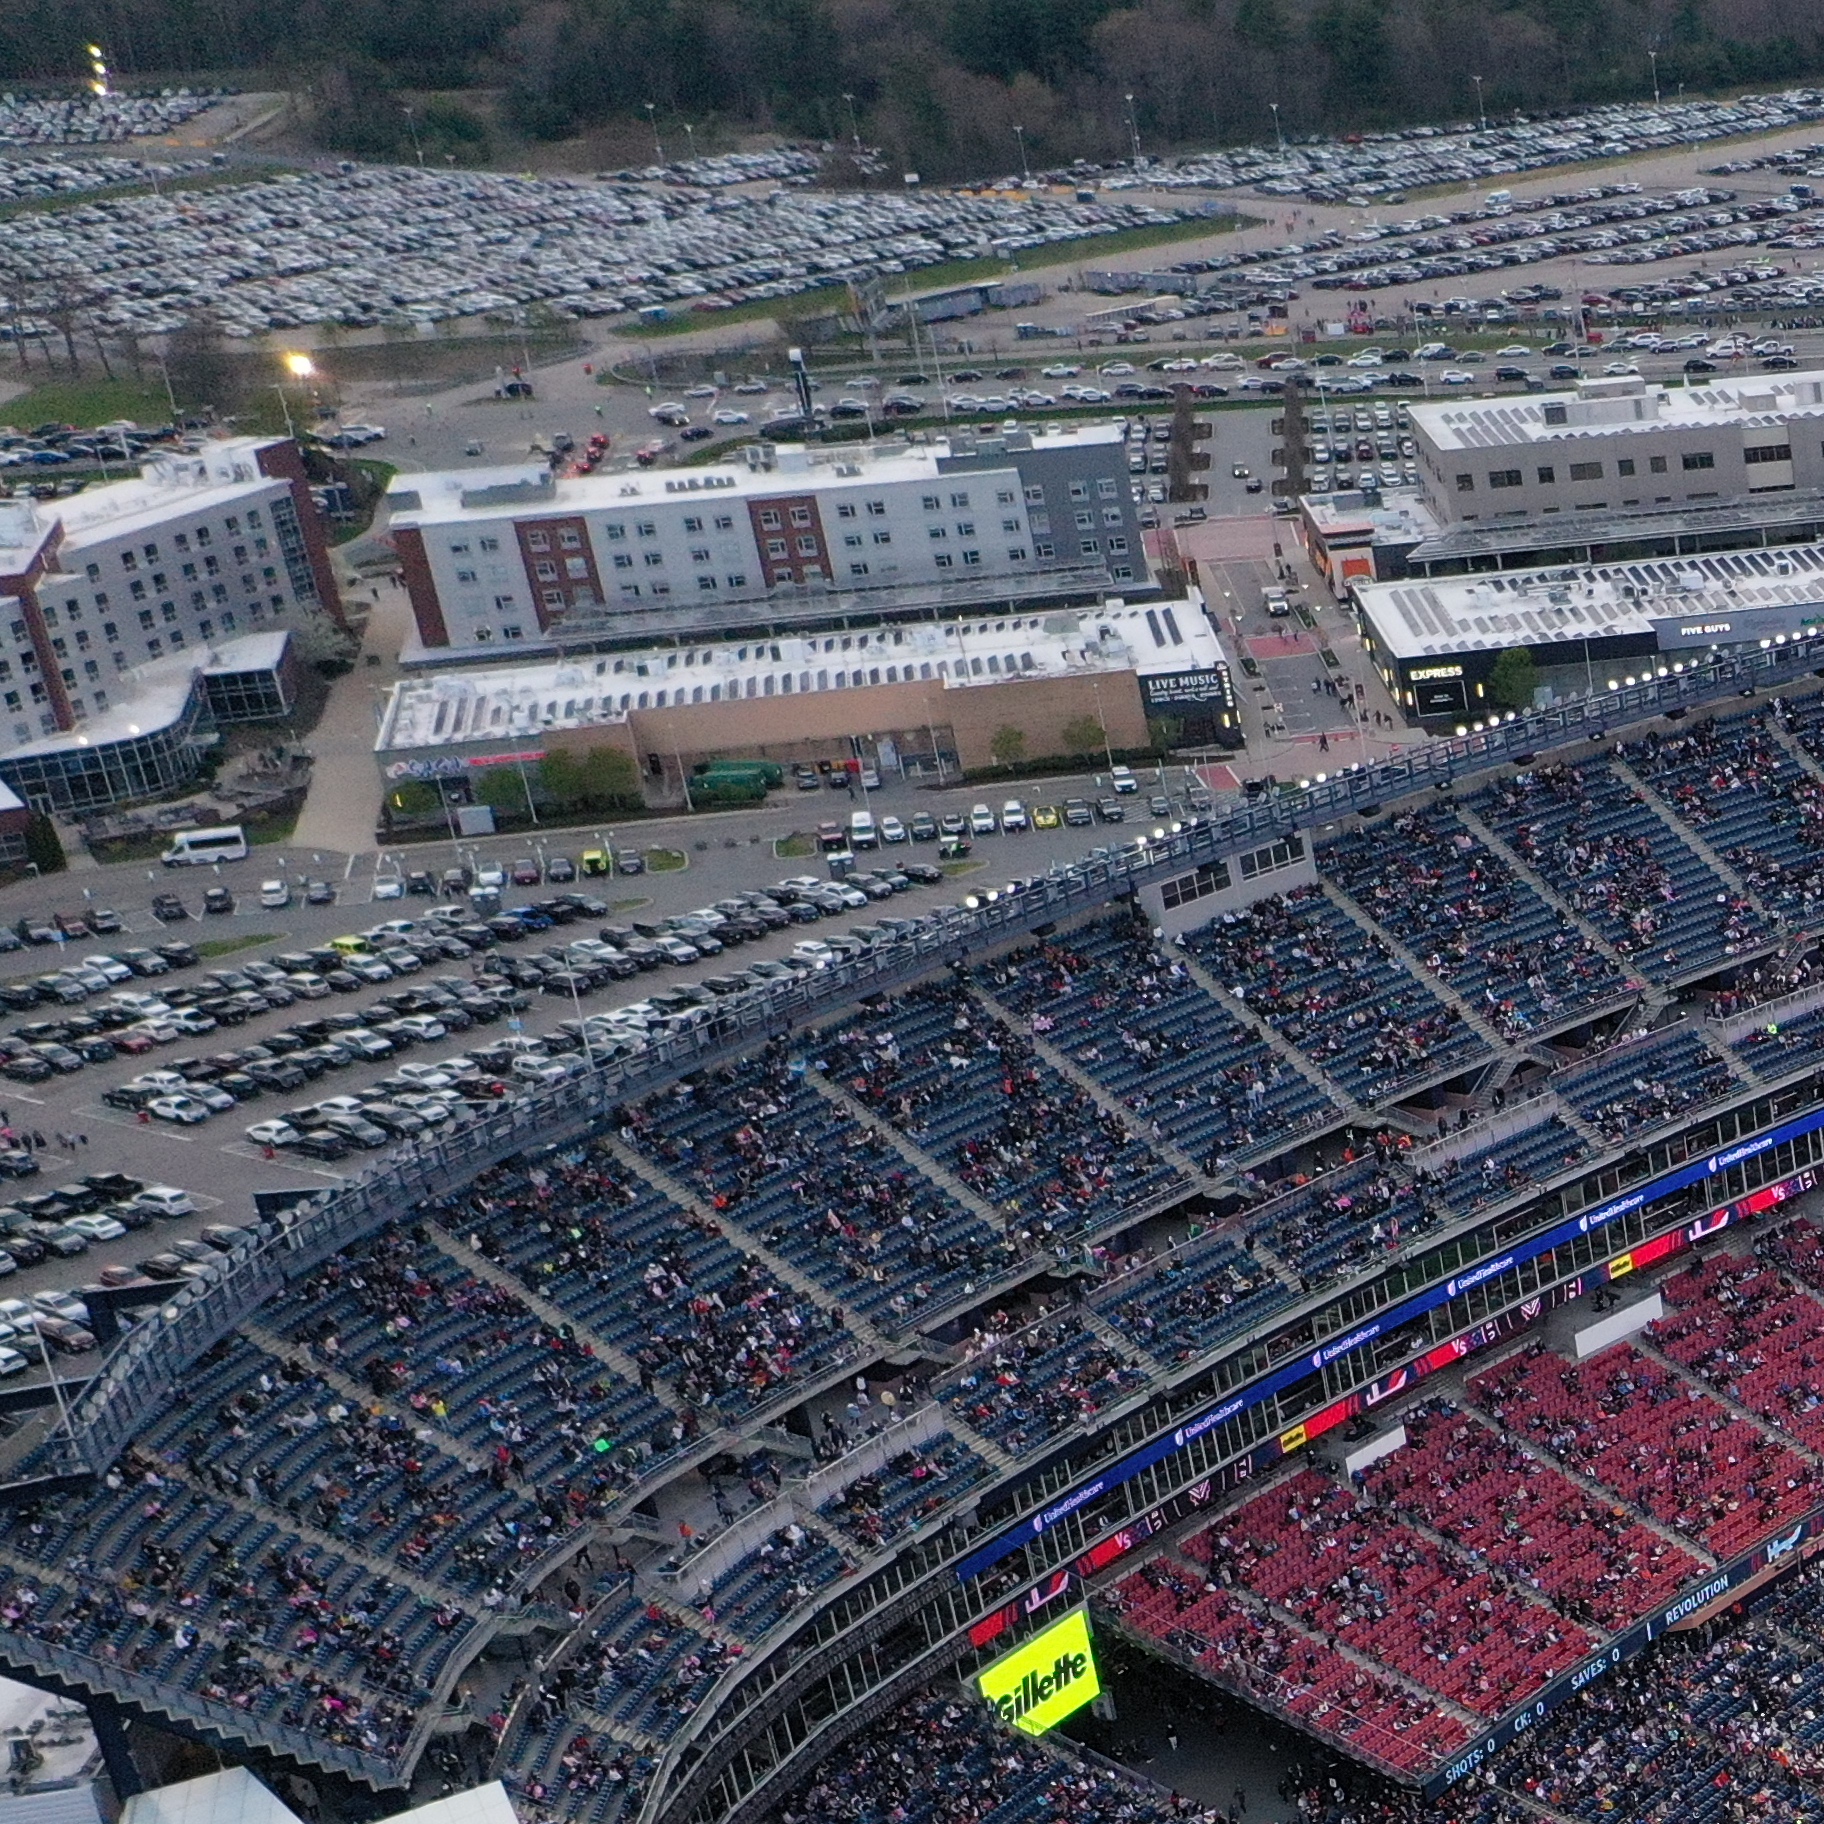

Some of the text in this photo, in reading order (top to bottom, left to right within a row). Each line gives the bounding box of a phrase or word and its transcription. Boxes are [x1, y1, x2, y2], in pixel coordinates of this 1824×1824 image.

[1148, 679, 1177, 690] LIVE
[1178, 674, 1218, 686] MUSIC
[1410, 666, 1463, 681] EXPRESS
[1665, 1574, 1729, 1626] REVOLUTION
[996, 1652, 1087, 1721] Gillette
[1571, 1648, 1619, 1690] SAVES: 0
[1514, 1702, 1544, 1732] CK: 0
[1445, 1738, 1495, 1785] SHOTS: 0
